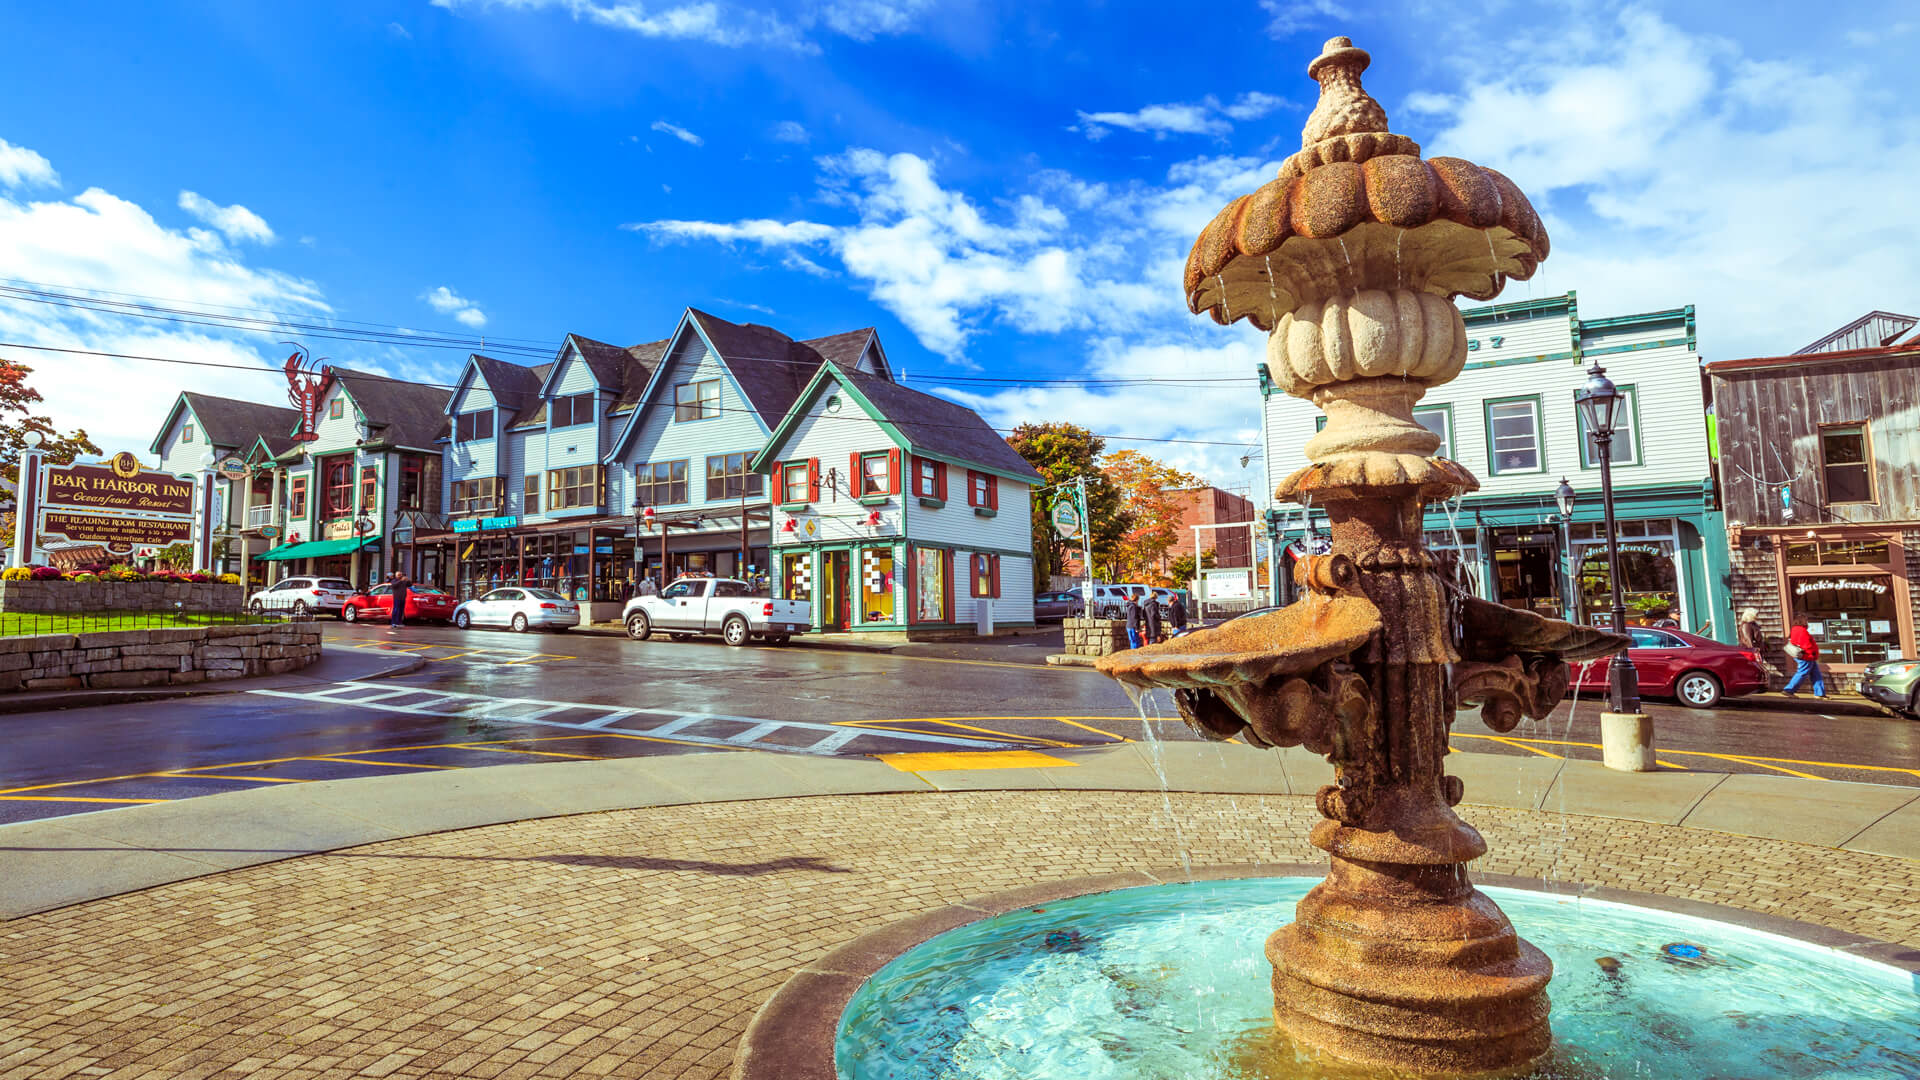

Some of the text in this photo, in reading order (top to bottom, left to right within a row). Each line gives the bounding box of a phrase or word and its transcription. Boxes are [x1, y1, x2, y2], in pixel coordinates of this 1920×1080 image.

[120, 459, 134, 467] BH
[53, 474, 190, 498] BAR HARBOR INN
[73, 491, 171, 508] Oceanfront Resort
[48, 514, 188, 530] THE READING ROOM RESTAURANT
[65, 523, 94, 532] Serving
[121, 527, 145, 535] nightly
[79, 533, 162, 544] Outdoor Waterfront Cafe
[1796, 579, 1887, 595] Jack's Jewelry
